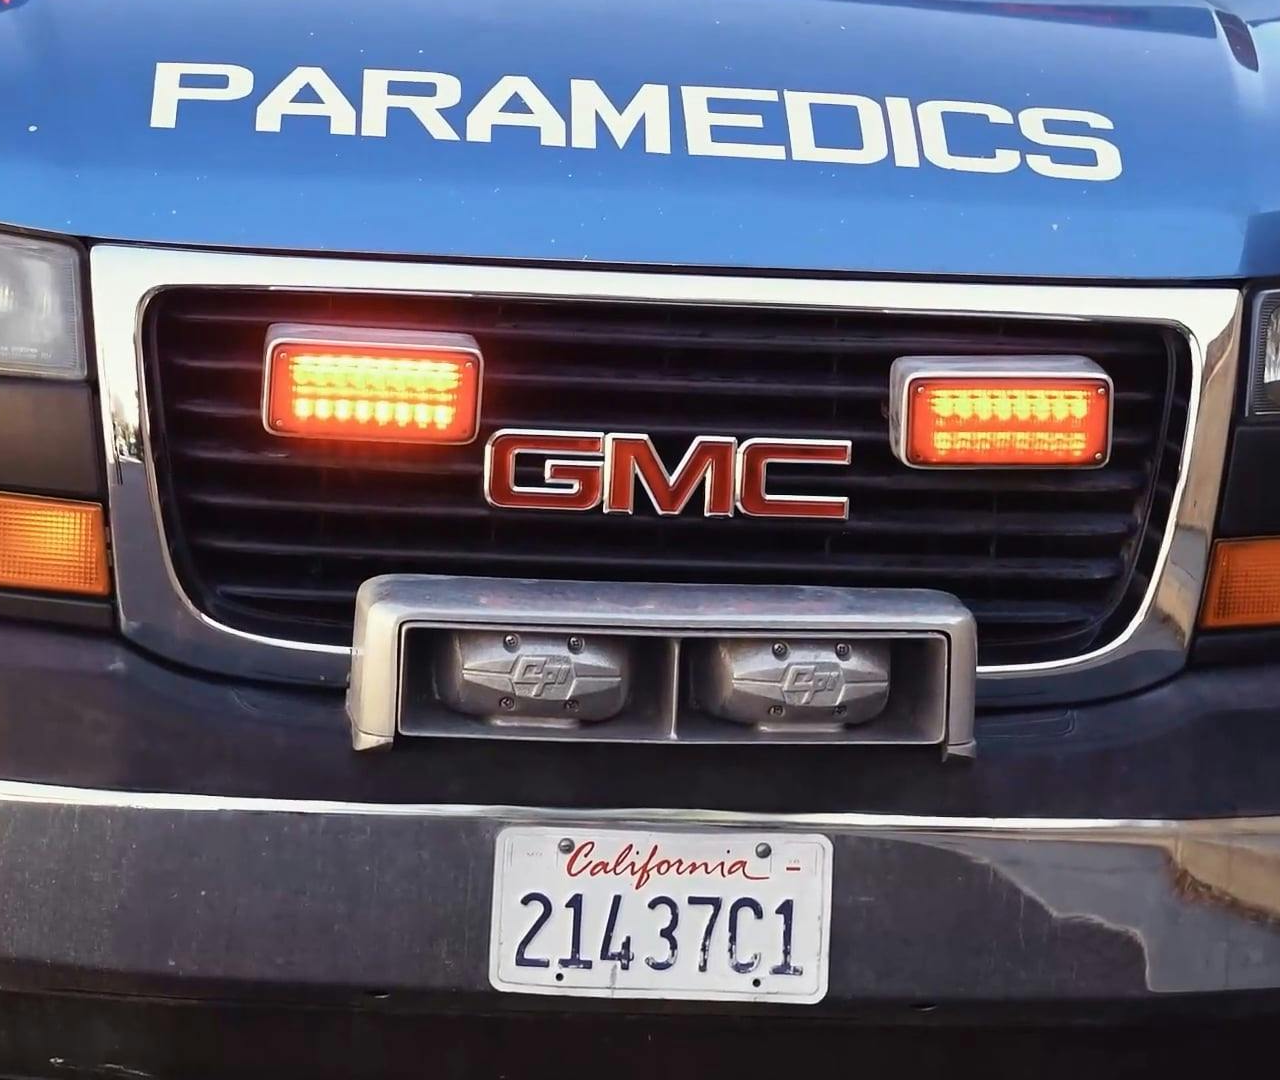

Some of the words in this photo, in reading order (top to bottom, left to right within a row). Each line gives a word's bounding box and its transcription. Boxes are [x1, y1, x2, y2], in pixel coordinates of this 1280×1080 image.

[149, 61, 1123, 182] PARAMEDICS
[483, 427, 852, 519] GMC
[566, 841, 769, 890] California
[515, 892, 803, 976] 21437C1
